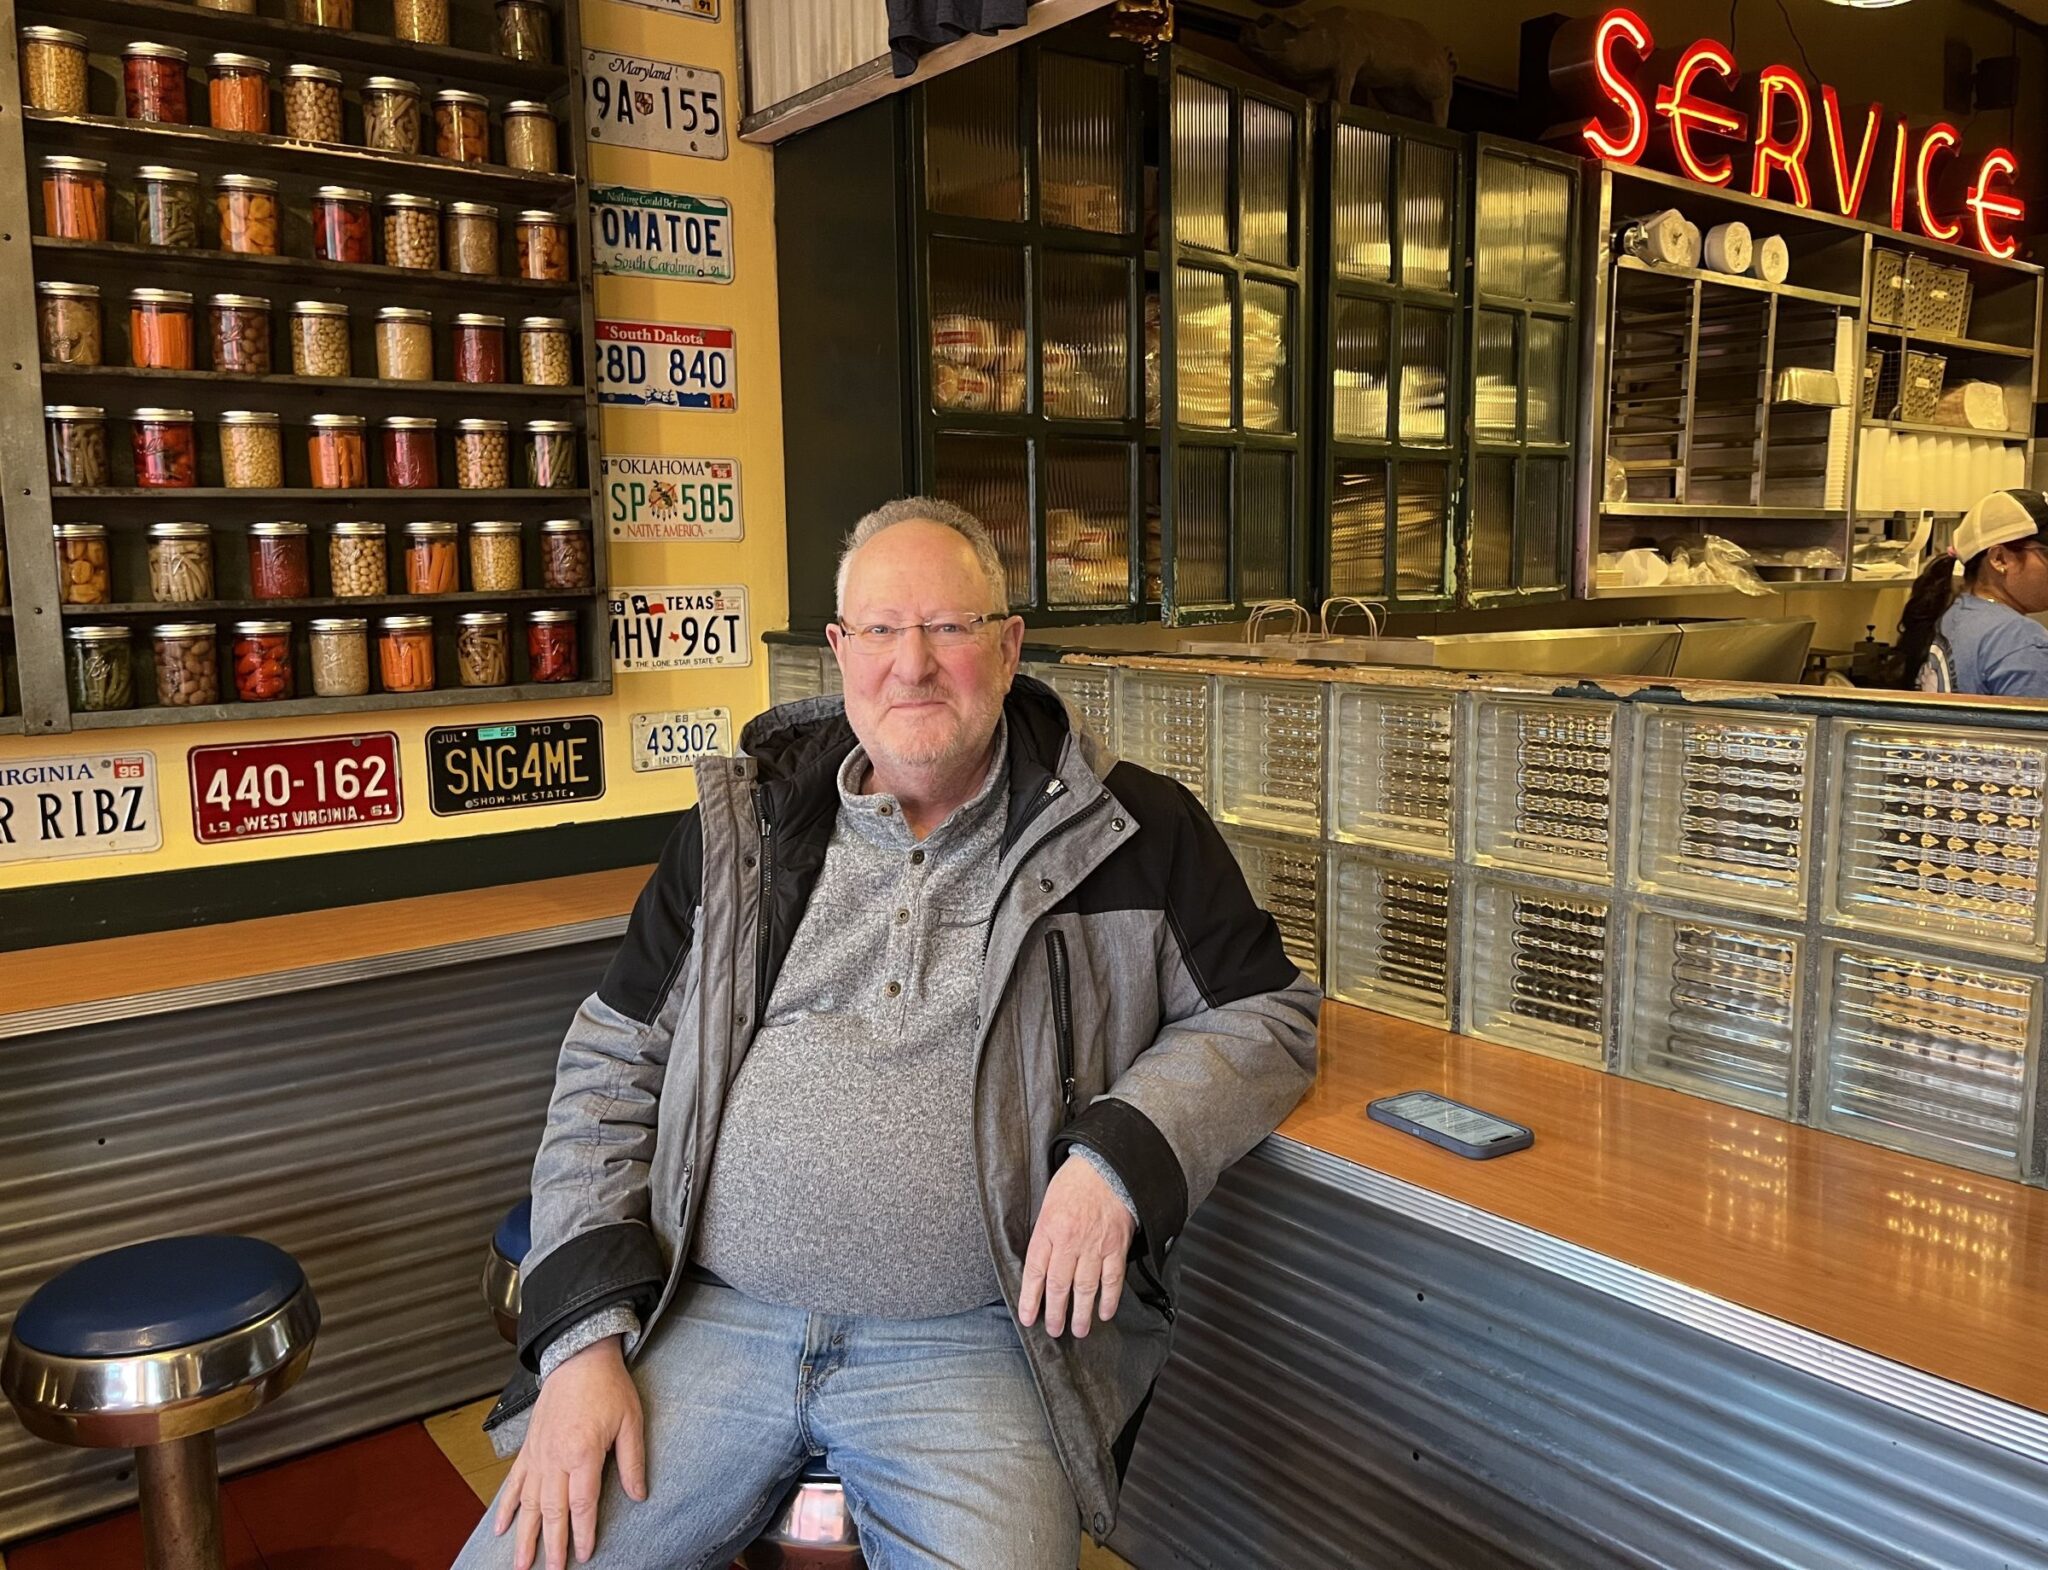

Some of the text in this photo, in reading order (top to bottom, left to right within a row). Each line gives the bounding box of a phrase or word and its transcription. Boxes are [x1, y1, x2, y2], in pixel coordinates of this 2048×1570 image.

[608, 57, 673, 83] Maryland
[583, 75, 720, 136] 9A 155
[1583, 7, 2025, 260] SERVICE
[607, 191, 639, 206] Nothing
[640, 196, 663, 208] Could
[602, 207, 722, 258] OMATOE
[614, 253, 646, 270] South
[648, 256, 696, 275] Carolina
[608, 326, 704, 345] South Dakota
[669, 348, 727, 389] 840
[619, 459, 705, 476] OKLAHOMA
[611, 482, 734, 523] SP 585
[627, 524, 704, 537] NATIVE AMERICA
[666, 596, 714, 611] TEXAS
[681, 615, 740, 657] 96T
[437, 733, 460, 744] JUL
[531, 726, 551, 736] MO
[646, 723, 718, 755] 43302
[445, 738, 589, 795] SNG4ME
[658, 753, 706, 765] INDIAN
[118, 765, 141, 778] 96
[205, 755, 388, 812] 440-162
[472, 790, 568, 807] SHOW-ME STATE
[37, 786, 146, 840] RIBZ
[207, 822, 231, 834] 19
[243, 813, 288, 832] WEST
